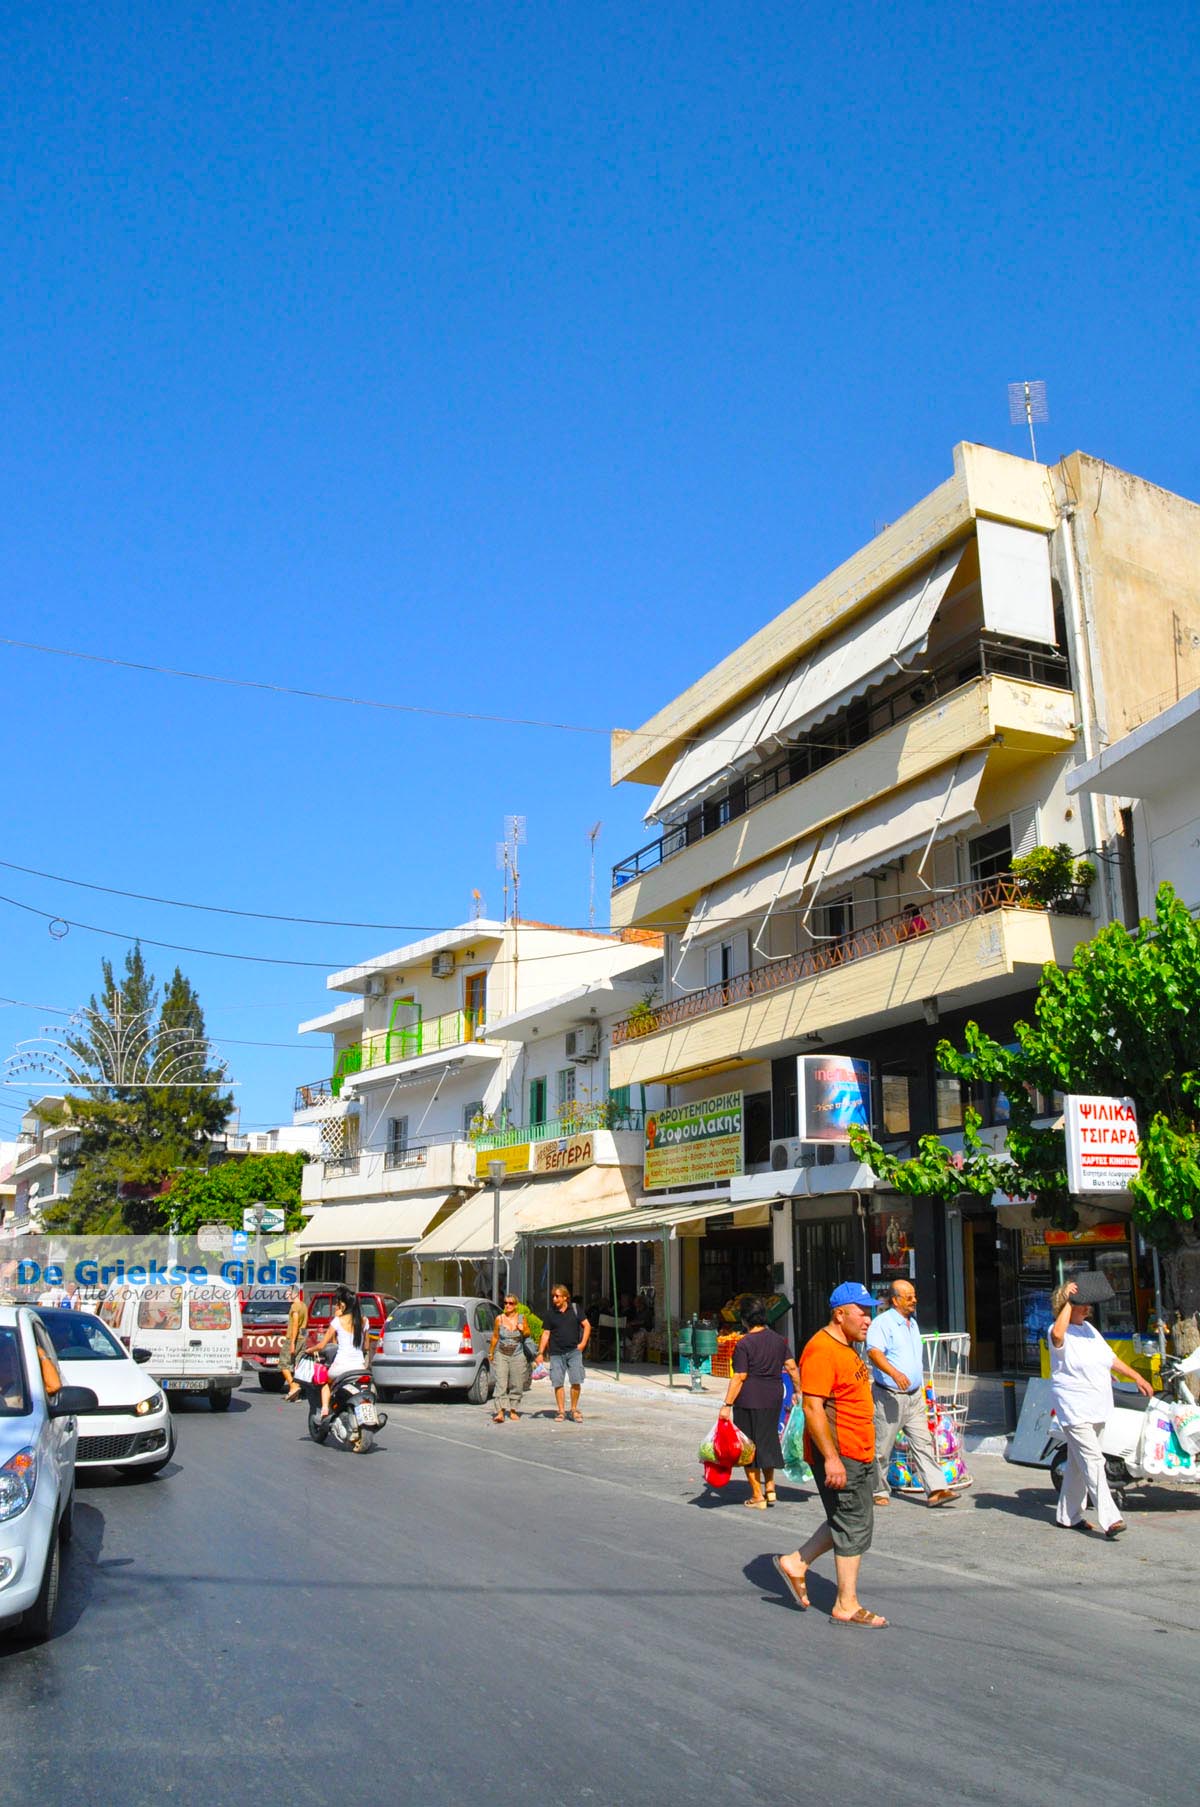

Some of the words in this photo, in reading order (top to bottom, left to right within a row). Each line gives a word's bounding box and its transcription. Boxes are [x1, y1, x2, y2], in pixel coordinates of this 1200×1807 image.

[659, 1092, 741, 1124] ΦΡΟΥΤΕΜΠΟΡΙΚΗ
[1079, 1103, 1137, 1122] ΨΙΛΙΚΑ
[1080, 1127, 1137, 1144] ΤΣΙΓΑΡΑ
[1092, 1179, 1105, 1188] Bus
[247, 1335, 287, 1348] TOYO
